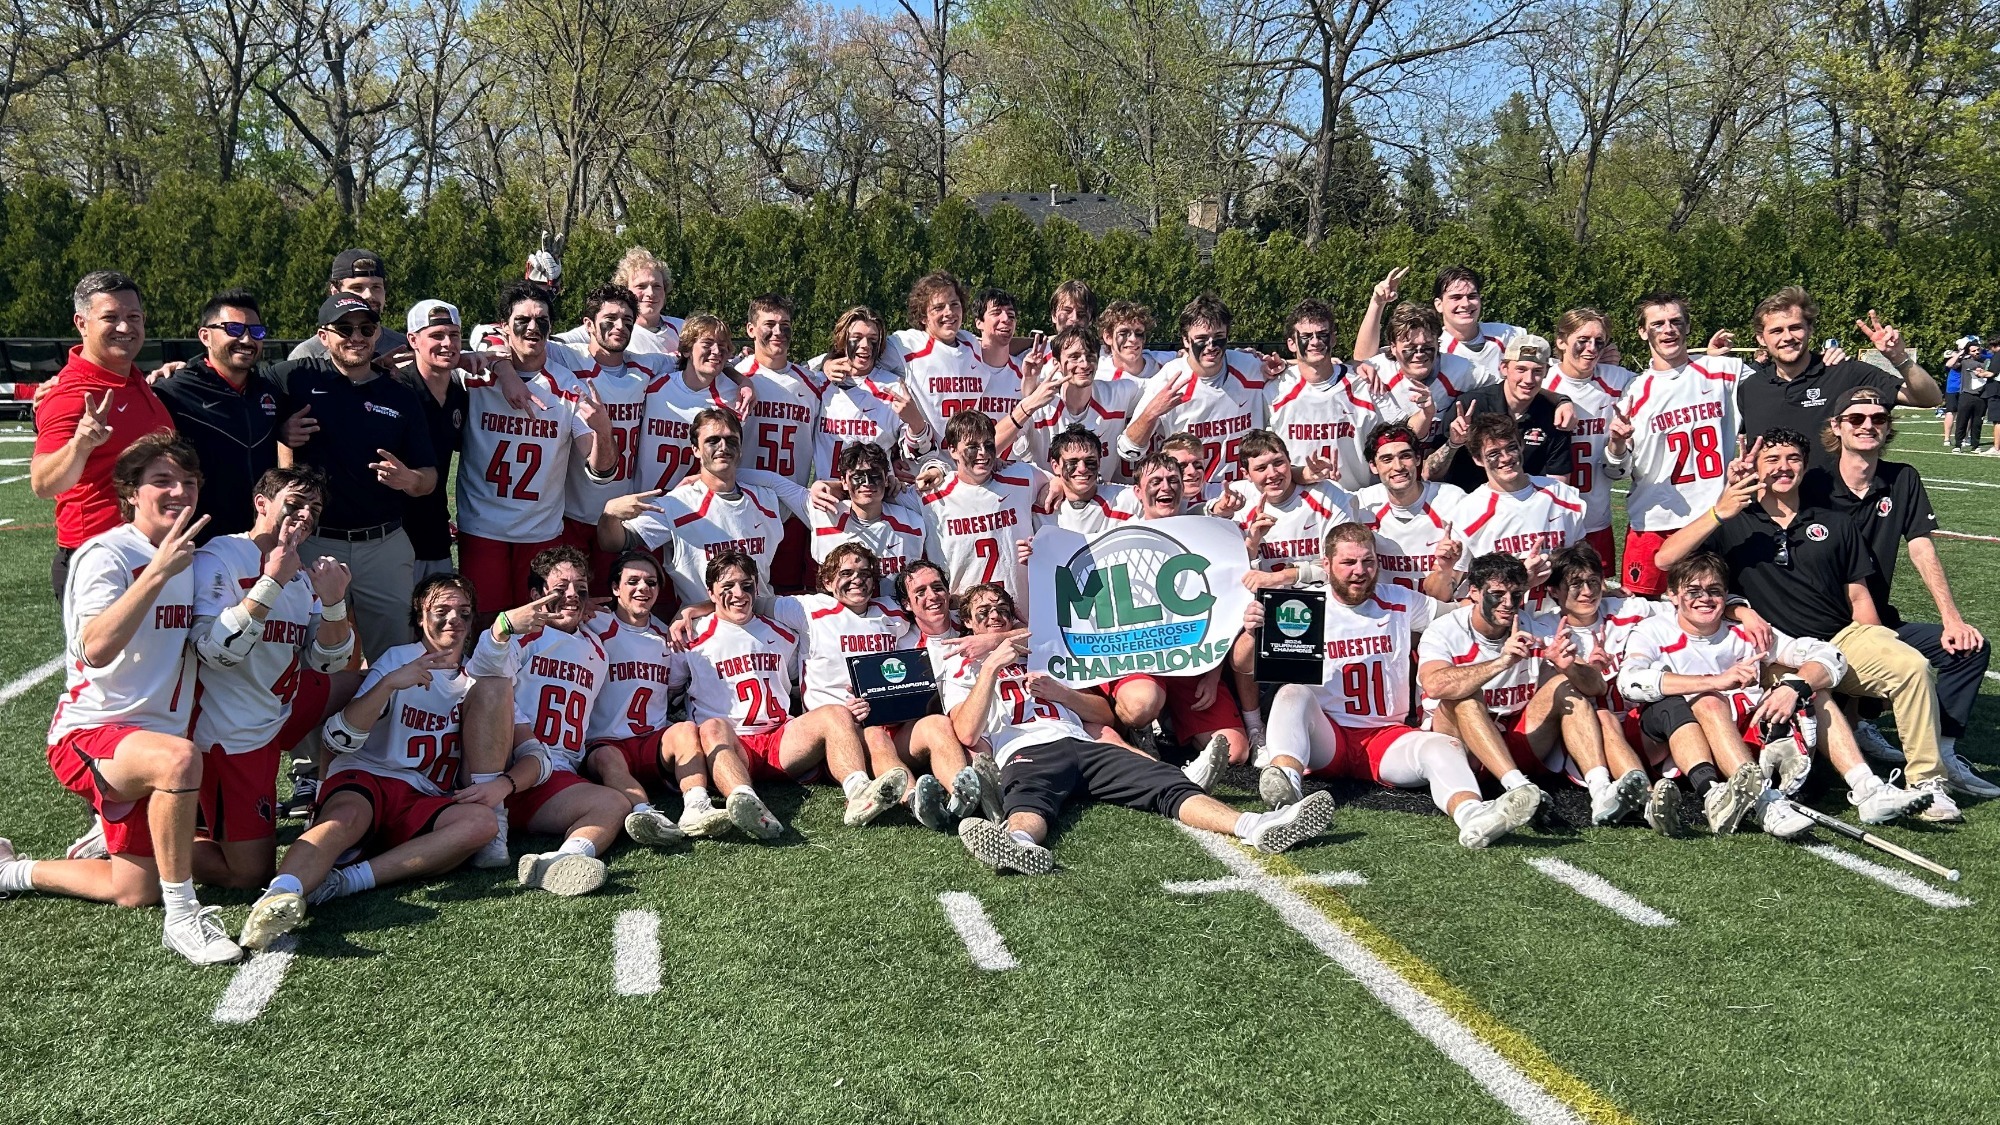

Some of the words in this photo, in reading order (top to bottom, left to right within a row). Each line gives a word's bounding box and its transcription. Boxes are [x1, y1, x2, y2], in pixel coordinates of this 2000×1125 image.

[929, 377, 983, 393] FORESTERS
[481, 411, 559, 439] FORESTERS
[819, 416, 878, 437] FORESTERS
[1188, 412, 1252, 438] FORESTERS
[1288, 421, 1355, 441] FORESTERS
[1651, 401, 1724, 433] FORESTERS
[756, 423, 798, 477] 55
[1203, 437, 1244, 484] 25
[1667, 425, 1723, 485] 28
[486, 440, 543, 501] 42
[1570, 442, 1592, 493] 6
[947, 508, 1018, 536] FORESTERS
[975, 538, 1004, 587] 2
[1258, 537, 1320, 559] ORESTERS
[1377, 553, 1437, 572] FORESTER
[1055, 553, 1217, 629] MLC
[1276, 606, 1312, 624] MLC
[1072, 632, 1130, 645] MIDWEST
[1133, 623, 1197, 641] LACROSSE
[1091, 635, 1182, 653] CONFERENCE
[530, 655, 594, 691] FORESTER
[609, 661, 671, 685] FORESTERS
[880, 662, 907, 675] MLC
[1048, 637, 1230, 681] CHAMPIONS
[736, 678, 787, 726] 24
[1342, 661, 1388, 717] 91
[533, 684, 587, 752] 69
